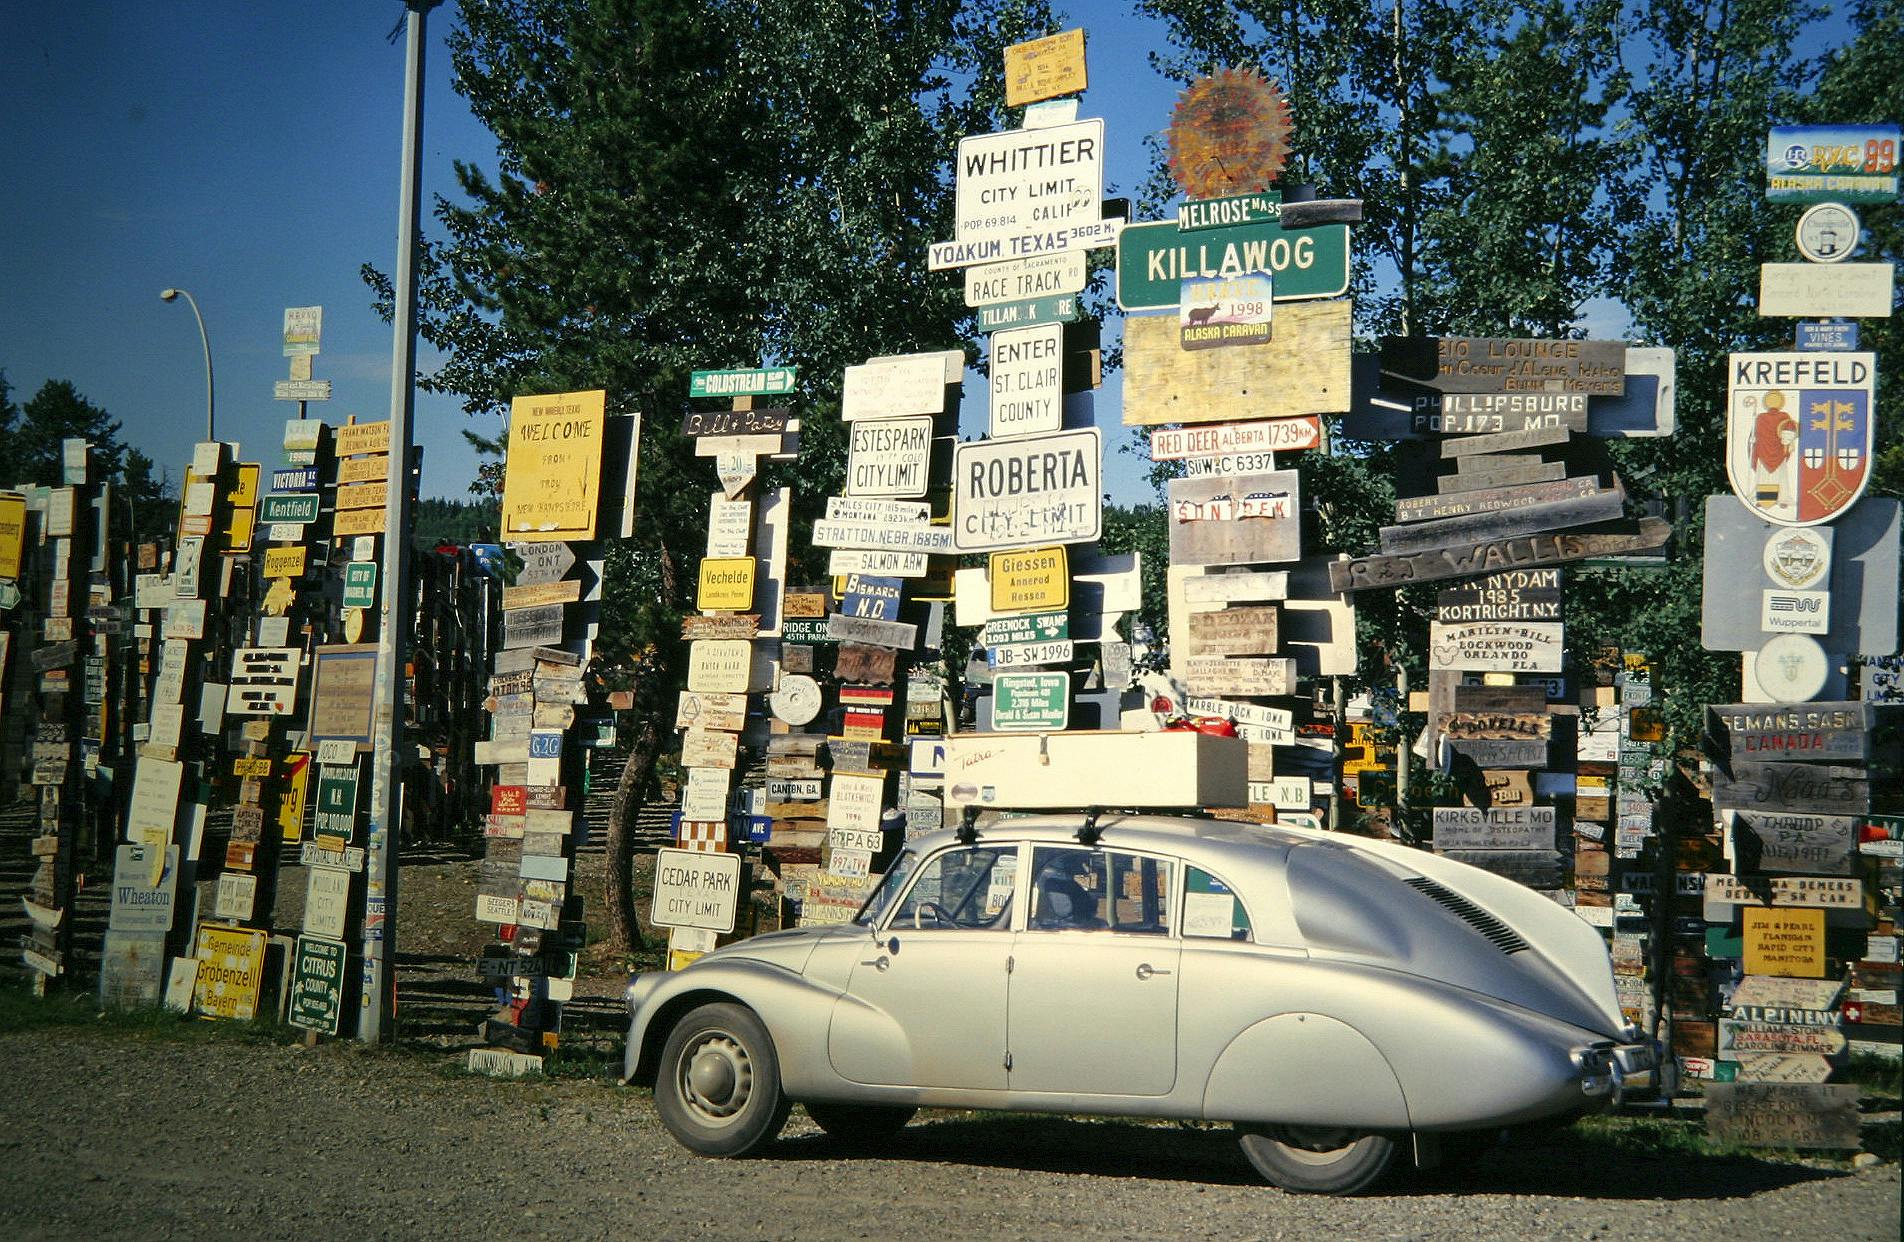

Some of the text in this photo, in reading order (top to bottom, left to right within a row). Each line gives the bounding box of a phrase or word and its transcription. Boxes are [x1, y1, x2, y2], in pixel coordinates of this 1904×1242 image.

[966, 138, 1095, 178] WHITTIER
[1864, 139, 1895, 173] 99
[981, 178, 1076, 205] CITY LIMIT
[1179, 198, 1283, 229] MELROSE MASS
[1010, 225, 1101, 255] TEXAS 3602
[1149, 237, 1315, 281] KILLAWOG
[973, 280, 1008, 301] RACE
[1016, 270, 1062, 294] TRACK
[1229, 302, 1264, 317] 1998
[1184, 322, 1268, 343] ALASKA CARAVAN
[996, 337, 1057, 365] ENTER
[1488, 341, 1580, 361] LOUNGE
[1017, 367, 1058, 392] CLAIR
[1735, 360, 1868, 385] KREFELD
[999, 399, 1052, 423] COUNTY
[521, 419, 593, 442] WELCOME
[1157, 433, 1183, 456] RED
[1187, 430, 1220, 453] DEER
[1222, 429, 1265, 446] ALBERTA
[1267, 423, 1299, 445] 1739
[1220, 456, 1233, 473] C
[1235, 453, 1272, 472] 6337
[273, 471, 307, 489] VICTORIA
[856, 463, 920, 488] CITY LIMIT
[970, 449, 1089, 499] ROBERTA
[269, 500, 312, 517] Kentfield
[840, 500, 863, 511] MILES
[966, 512, 1012, 534] CITY
[520, 542, 563, 556] LONDON
[1442, 533, 1584, 574] WALLIS
[537, 554, 561, 568] ONT
[861, 552, 923, 571] SALMON ARM
[1002, 555, 1057, 574] Giessen
[706, 570, 749, 585] Vechelde
[846, 574, 901, 599] BISMARCK
[1487, 571, 1558, 590] NYDAM
[1479, 588, 1521, 606] 1985
[985, 614, 1068, 633] GREENOCK SWAMP
[1768, 616, 1822, 629] Wuppertal
[1041, 643, 1071, 661] 1996
[1459, 640, 1534, 652] LOCKWOOD
[1464, 650, 1529, 661] ORLANDO
[1511, 660, 1539, 671] FLA
[1228, 704, 1251, 719] ROCK
[1261, 712, 1283, 725] IOWA
[1745, 733, 1824, 752] CANADA
[1435, 810, 1524, 825] KIRKSVILLE
[752, 822, 766, 835] AVE
[866, 834, 882, 850] 63
[661, 867, 731, 892] CEDAR PARK
[1799, 880, 1853, 892] DEMERS
[118, 886, 170, 906] Wheaton
[669, 898, 722, 918] CITY LIMIT
[207, 936, 252, 958] Gemeinde
[302, 956, 337, 979] CITRUS
[305, 978, 329, 994] COUNTY
[206, 990, 238, 1010] Bayern
